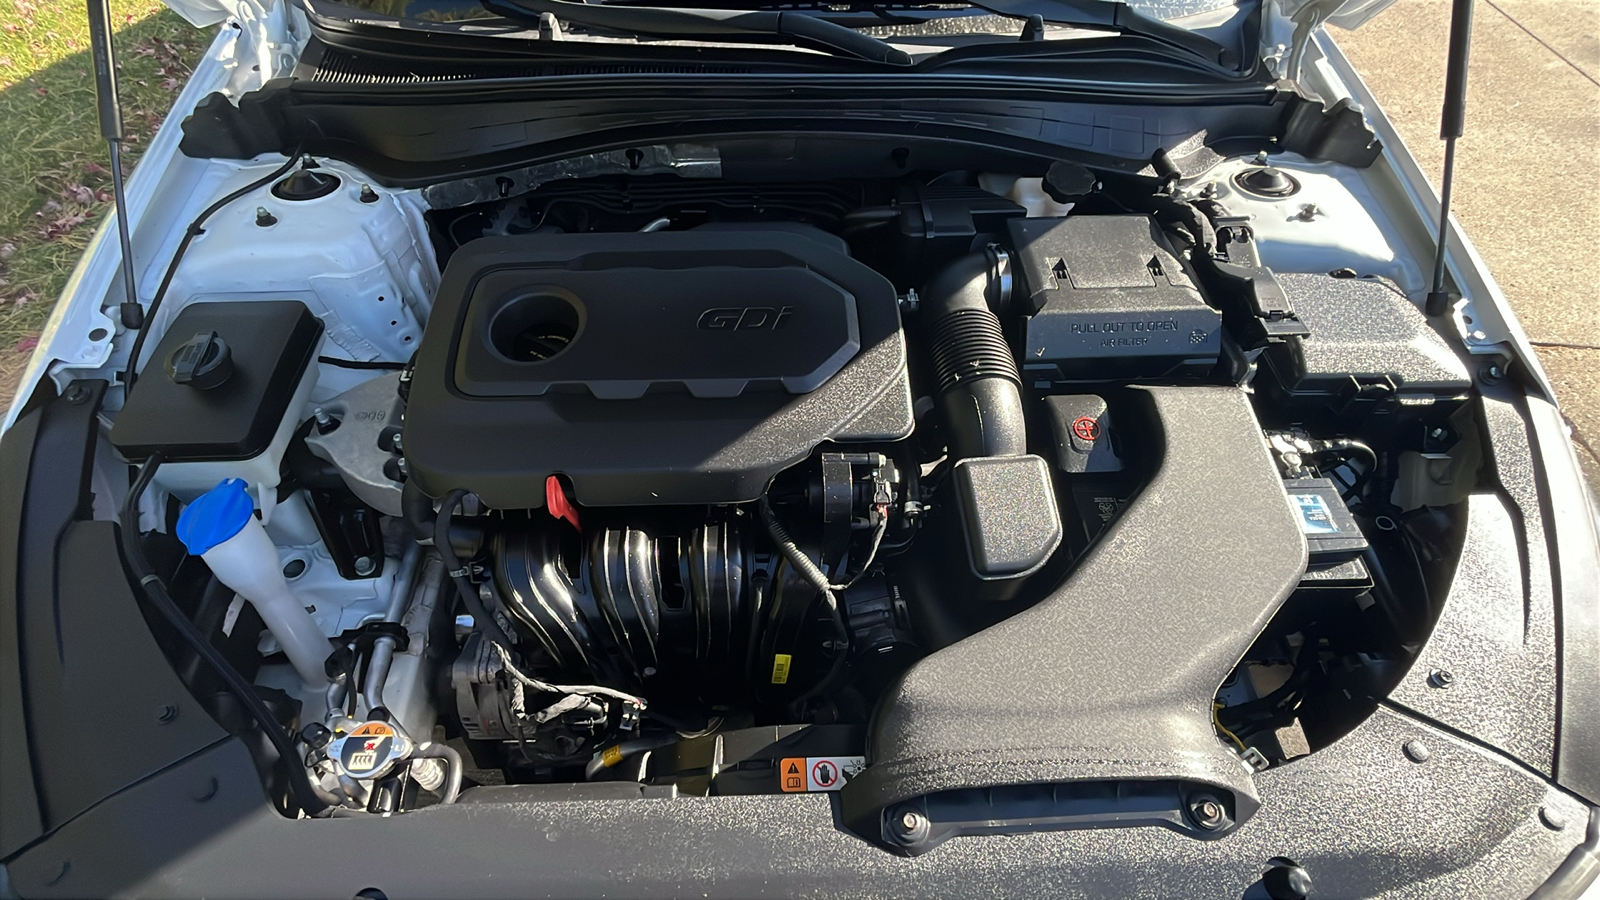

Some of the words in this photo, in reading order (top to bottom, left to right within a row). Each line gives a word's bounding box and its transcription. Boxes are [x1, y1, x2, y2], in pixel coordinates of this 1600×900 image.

[696, 305, 795, 331] GDi
[1070, 322, 1100, 334] PULL
[1102, 321, 1125, 333] OUT
[1129, 321, 1144, 332] TO
[1147, 320, 1179, 332] OPEN
[1100, 339, 1116, 348] AIR
[1117, 338, 1148, 347] FILTER
